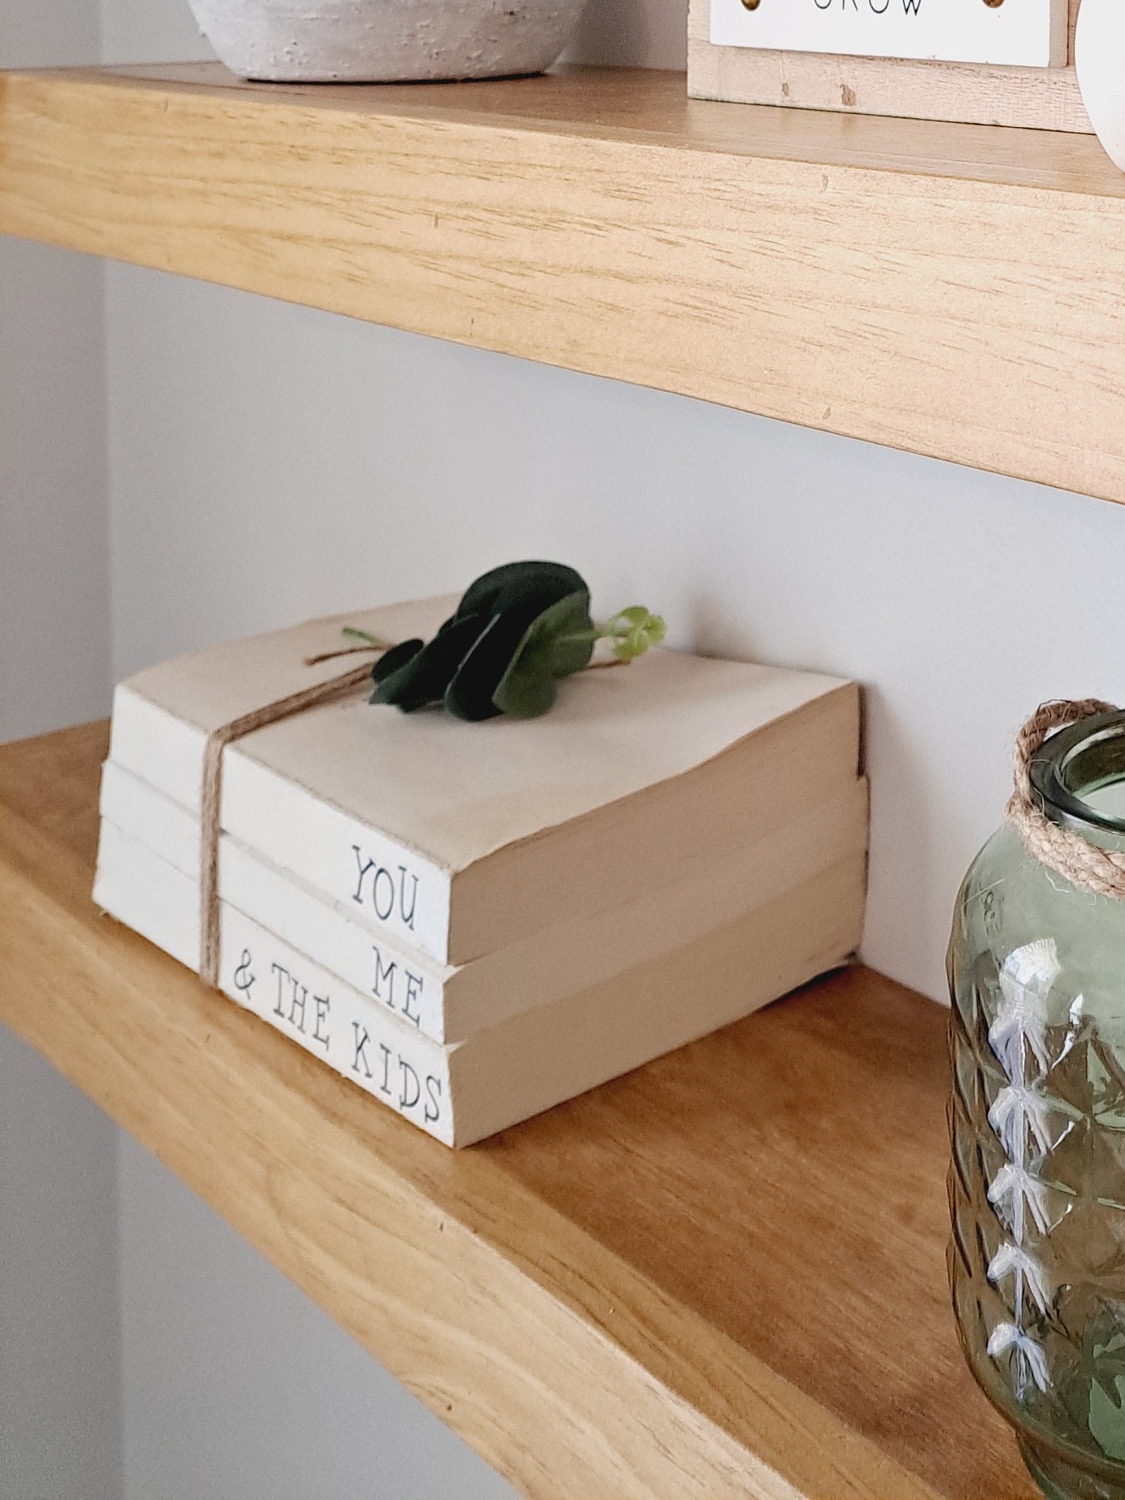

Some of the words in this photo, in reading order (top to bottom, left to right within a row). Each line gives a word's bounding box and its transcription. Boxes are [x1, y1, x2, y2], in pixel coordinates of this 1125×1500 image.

[351, 845, 419, 930] YOU
[371, 946, 423, 1028] ME
[233, 948, 257, 1000] &
[270, 962, 331, 1051] THE
[351, 1022, 442, 1123] KIDS
